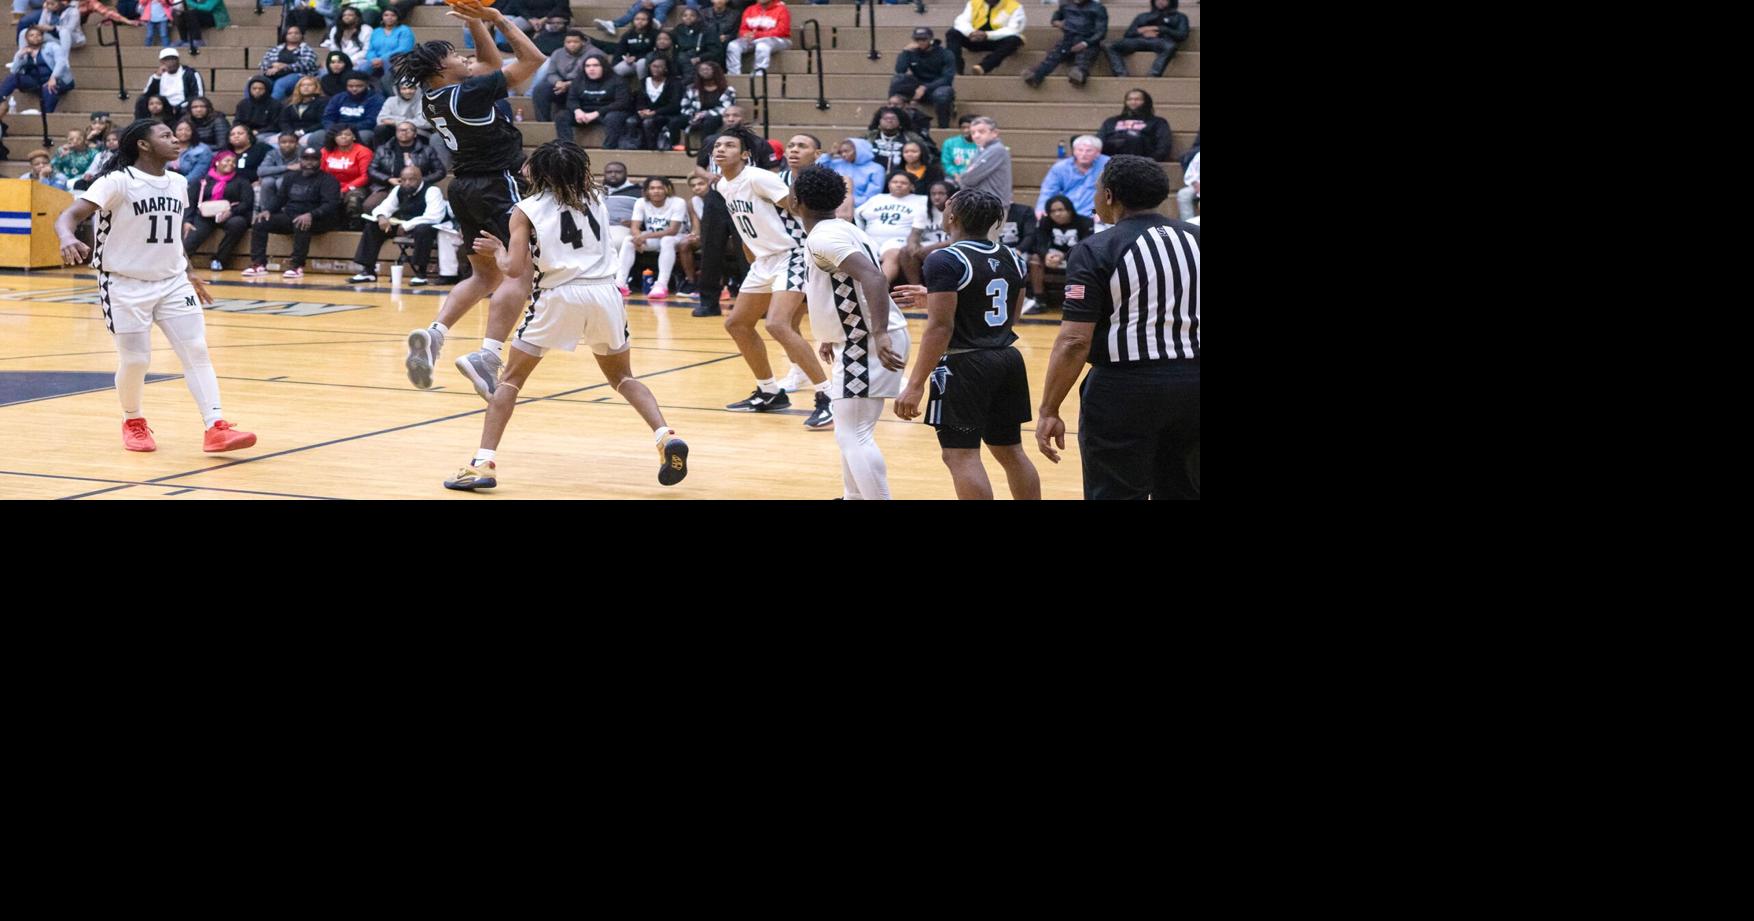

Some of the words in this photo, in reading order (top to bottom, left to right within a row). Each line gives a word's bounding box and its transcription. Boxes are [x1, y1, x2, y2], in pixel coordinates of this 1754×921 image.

[431, 117, 458, 151] 5
[873, 204, 913, 215] MARTIN
[880, 212, 901, 226] 42
[146, 215, 174, 244] 11
[184, 295, 197, 306] M
[984, 278, 1009, 327] 3
